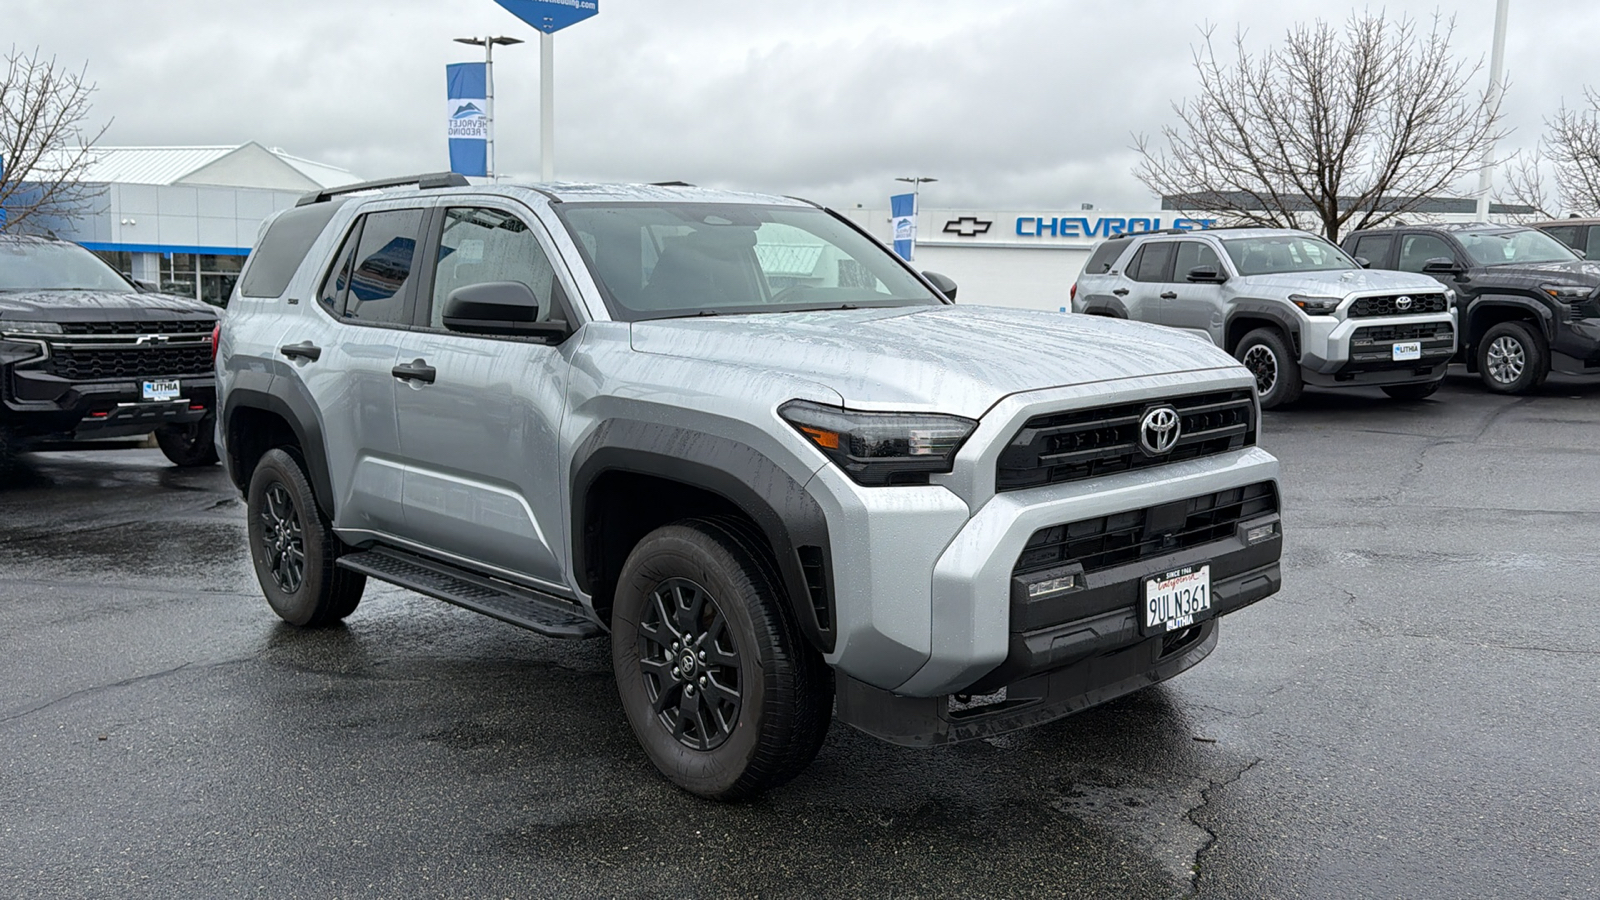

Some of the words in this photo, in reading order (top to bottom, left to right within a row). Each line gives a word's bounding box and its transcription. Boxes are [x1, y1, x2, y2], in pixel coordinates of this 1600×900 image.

[1016, 217, 1216, 237] CHEVROLET
[1400, 344, 1418, 353] LITHIA
[152, 383, 178, 391] LITHIA
[1166, 570, 1180, 579] SINCE
[1157, 573, 1199, 591] California
[1149, 584, 1208, 626] 9ULN361
